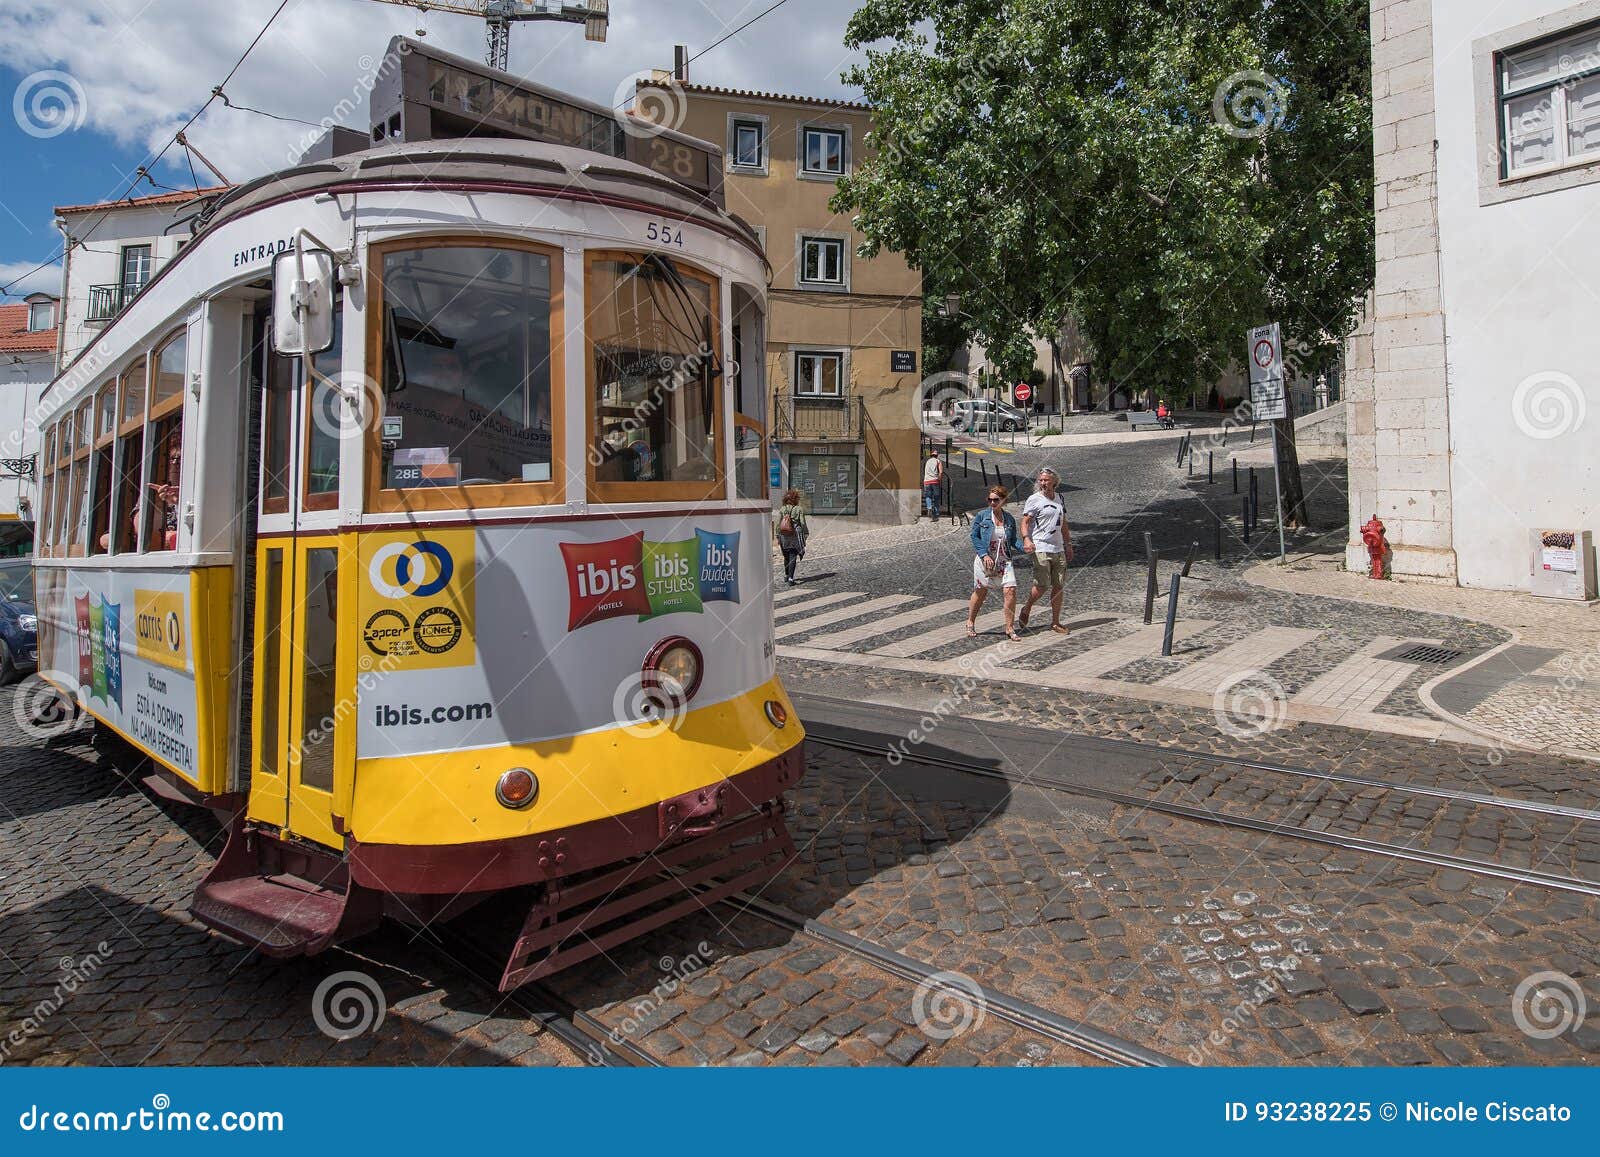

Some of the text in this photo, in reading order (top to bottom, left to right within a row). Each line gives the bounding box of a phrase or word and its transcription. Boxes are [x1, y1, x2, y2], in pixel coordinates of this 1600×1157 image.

[651, 139, 694, 178] 28
[647, 222, 683, 248] 554
[233, 236, 296, 267] ENTRADA
[1254, 329, 1270, 338] zona
[395, 468, 419, 480] 28E
[655, 553, 689, 578] ibis
[706, 544, 732, 566] ibis
[577, 559, 637, 597] ibis
[701, 566, 735, 584] budget
[598, 600, 623, 611] HOTELS
[663, 598, 683, 606] HOTELS
[372, 628, 402, 640] apcer
[148, 672, 167, 695] ibis.com
[137, 692, 184, 737] ESTÁ A DORMIR
[375, 702, 492, 727] ibis.com
[131, 715, 193, 771] NA CAMA PERFEITA!
